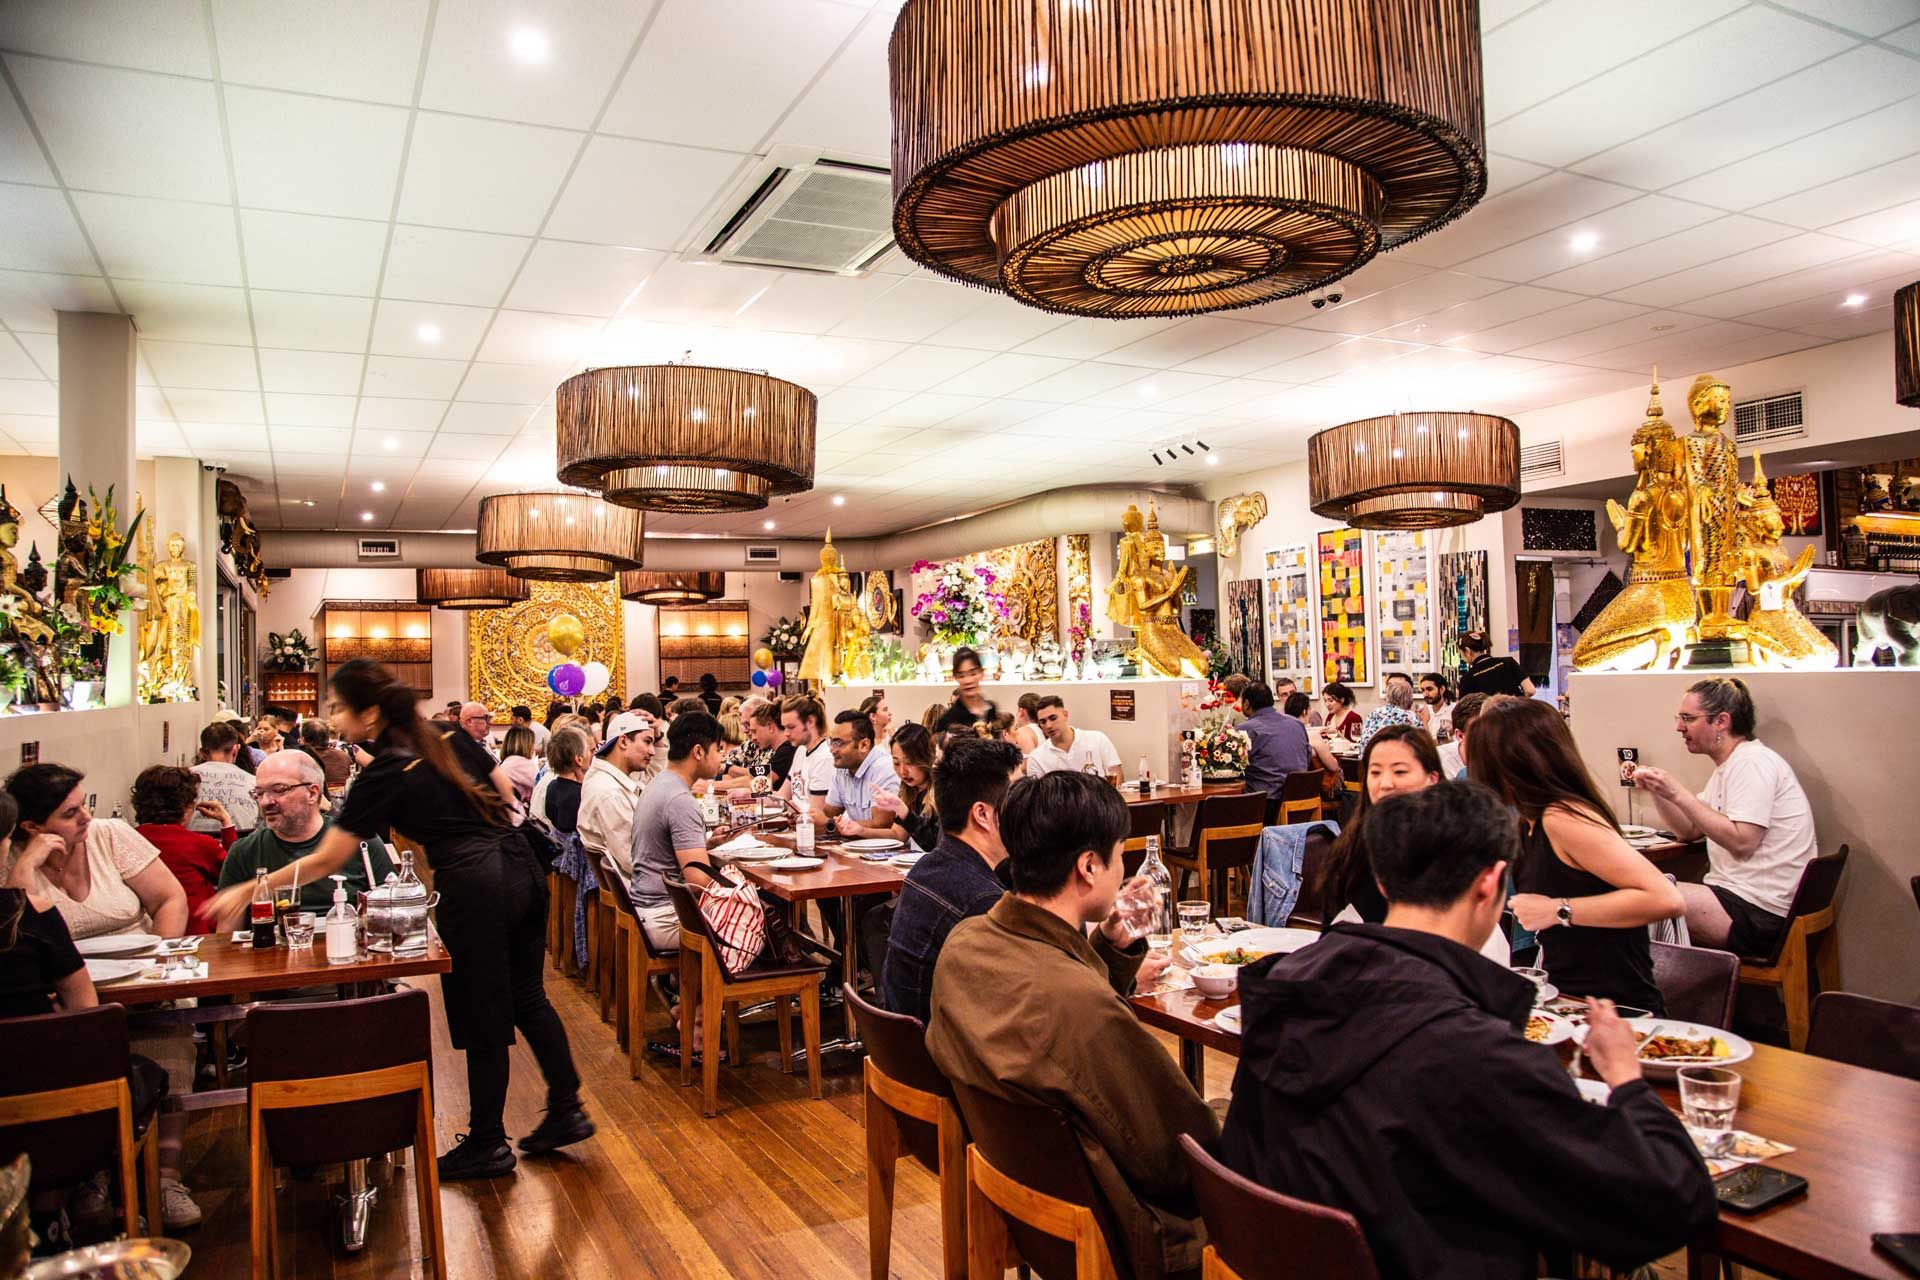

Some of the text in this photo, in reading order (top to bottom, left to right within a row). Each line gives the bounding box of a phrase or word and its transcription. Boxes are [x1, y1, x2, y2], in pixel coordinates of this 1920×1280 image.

[1623, 749, 1633, 760] 10
[755, 766, 765, 775] 14
[201, 787, 234, 796] MOVE
